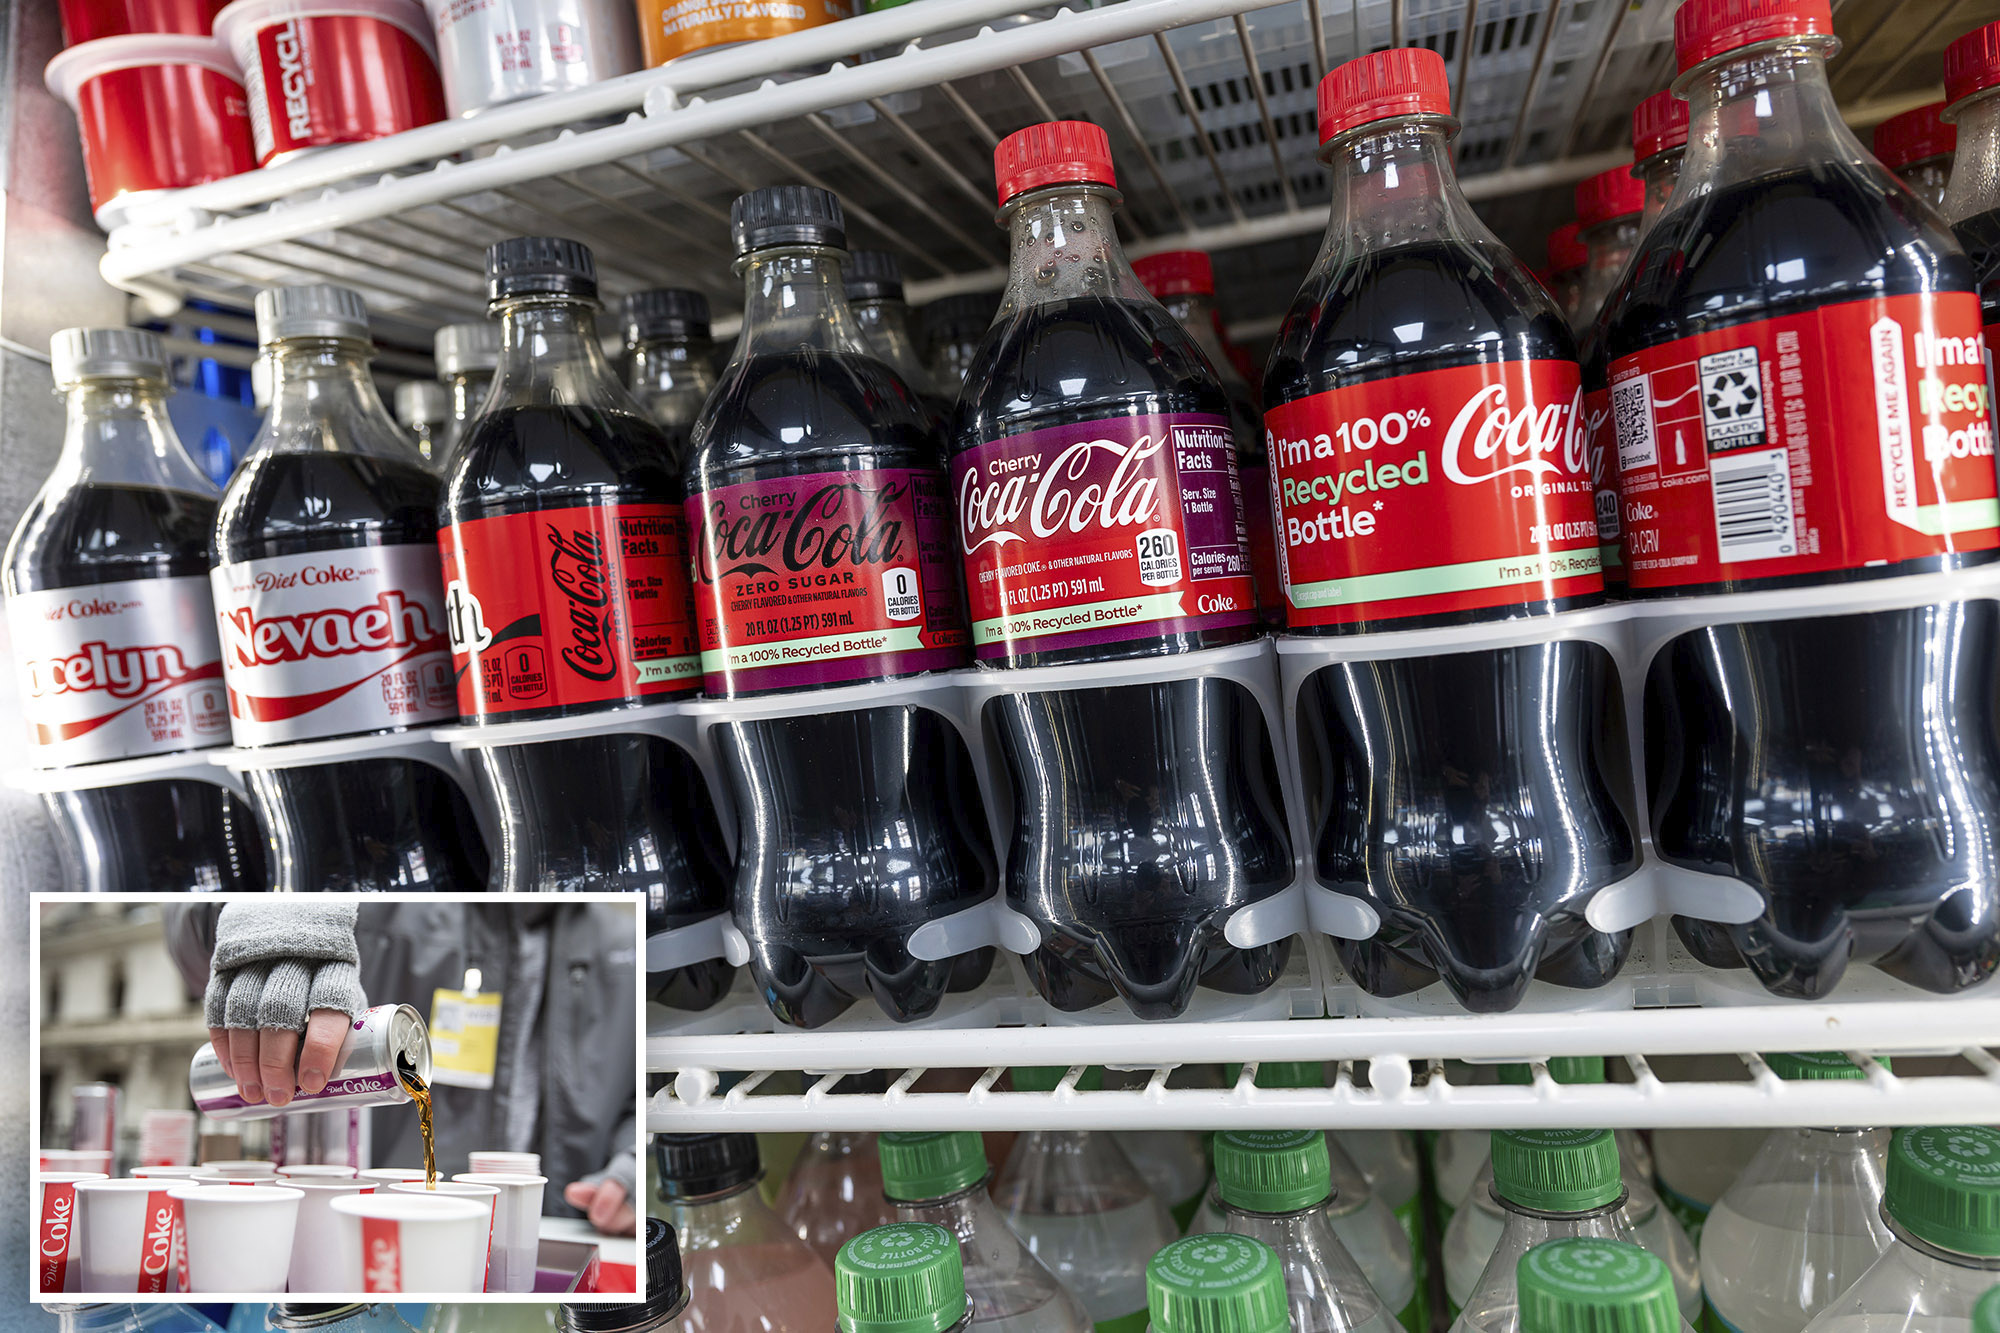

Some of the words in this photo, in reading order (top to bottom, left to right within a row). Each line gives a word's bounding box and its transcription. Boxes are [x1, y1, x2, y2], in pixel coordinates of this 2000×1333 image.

[664, 5, 732, 37] NATURALLY
[734, 3, 806, 20] FLAVORED
[1879, 329, 1899, 386] AGAIN
[1914, 332, 1965, 368] Im
[1886, 390, 1899, 419] ME
[1918, 379, 1990, 418] Recy
[1174, 429, 1225, 449] Nutrition
[1278, 437, 1312, 469] I'm
[1314, 433, 1335, 458] a
[1336, 407, 1432, 454] 100%
[1711, 421, 1759, 438] PLASTIC
[1713, 434, 1761, 450] BOTTLE
[1922, 421, 1994, 462] Bottl
[989, 453, 1042, 475] Cherry
[1177, 451, 1213, 470] Facts
[1267, 437, 1278, 484] AGAIN
[1889, 424, 1906, 507] RECYCLE
[1283, 450, 1430, 508] Recycled
[1510, 481, 1579, 498] ORGINAL
[1661, 473, 1710, 489] coke.com
[740, 491, 797, 511] Cherry
[960, 433, 1168, 556] Coca-Cola
[1182, 489, 1202, 501] Serv.
[1202, 487, 1217, 499] Size
[1273, 487, 1281, 513] ME
[1597, 493, 1616, 516] 240
[1184, 503, 1190, 514] 1
[1191, 501, 1214, 513] Bottle
[1626, 502, 1653, 522] Coke
[619, 519, 675, 537] Nutrition
[698, 481, 910, 586] Coca-Cola
[621, 538, 659, 555] Facts
[1139, 534, 1175, 559] 260
[1276, 515, 1290, 586] RECYCLE
[1629, 531, 1640, 555] CA
[1640, 528, 1659, 554] CRV
[1023, 561, 1040, 575] COKE
[1048, 560, 1053, 570] &
[1052, 557, 1074, 569] OTHER
[1074, 553, 1103, 567] NATURAL
[1104, 549, 1133, 564] FLAVORS
[1140, 558, 1178, 571] CALORIES
[1191, 551, 1226, 566] Calories
[1227, 555, 1241, 572] 260
[1192, 567, 1202, 577] per
[1202, 564, 1223, 575] serving
[1499, 564, 1520, 579] I'm
[1524, 565, 1533, 575] a
[1535, 559, 1567, 574] 10%
[255, 571, 298, 592] Diet
[301, 565, 354, 587] Coke
[607, 562, 620, 604] SUGAR
[735, 580, 780, 597] ZERO
[788, 572, 855, 590] SUGAR
[896, 574, 907, 595] 0
[1142, 571, 1155, 582] PER
[1156, 569, 1179, 580] BOTTLE
[731, 600, 753, 613] CHERRY
[753, 596, 787, 610] FLAVORED
[793, 593, 812, 604] OTHER
[813, 590, 840, 602] NATURAL
[841, 587, 868, 599] FLAVORS
[887, 595, 919, 607] CALORIES
[1009, 590, 1018, 605] FL
[1018, 588, 1029, 604] OZ
[1030, 584, 1051, 603] (1.25
[1052, 580, 1069, 599] PT)
[1070, 578, 1087, 596] 591
[1089, 576, 1105, 593] mL
[67, 598, 122, 619] Coke
[547, 524, 618, 682] Coca-Cola
[888, 607, 900, 617] PER
[900, 606, 920, 616] BOTTLE
[1197, 594, 1233, 614] Coke
[221, 591, 434, 667] Nevaeh
[614, 609, 625, 642] ZERO
[746, 621, 756, 637] 20
[757, 620, 766, 635] FL
[767, 618, 779, 634] OZ
[780, 615, 801, 635] (1.25
[803, 613, 819, 631] PT)
[821, 612, 837, 628] 591
[838, 611, 854, 626] mL
[985, 627, 997, 638] I'm
[997, 626, 1003, 636] a
[1033, 611, 1091, 631] Recycled
[632, 635, 672, 648] Calories
[741, 653, 748, 663] a
[748, 648, 780, 663] 100%
[782, 640, 840, 659] Recycled
[492, 658, 502, 672] OZ
[518, 652, 530, 673] 0
[646, 665, 662, 677] I'm
[665, 665, 671, 674] a
[673, 662, 696, 674] 100%
[434, 665, 446, 685] 0
[491, 673, 504, 688] PT)
[510, 673, 543, 685] CALORIES
[511, 684, 523, 693] PER
[523, 682, 544, 692] BOTTLE
[326, 1085, 343, 1094] Diet
[342, 1079, 383, 1094] Coke
[1543, 1129, 1574, 1138] WITH
[41, 1197, 72, 1257] Coke
[143, 1208, 173, 1276] Coke
[880, 1246, 923, 1260] BOTTLE
[43, 1258, 59, 1287] Diet
[150, 1278, 160, 1293] iet
